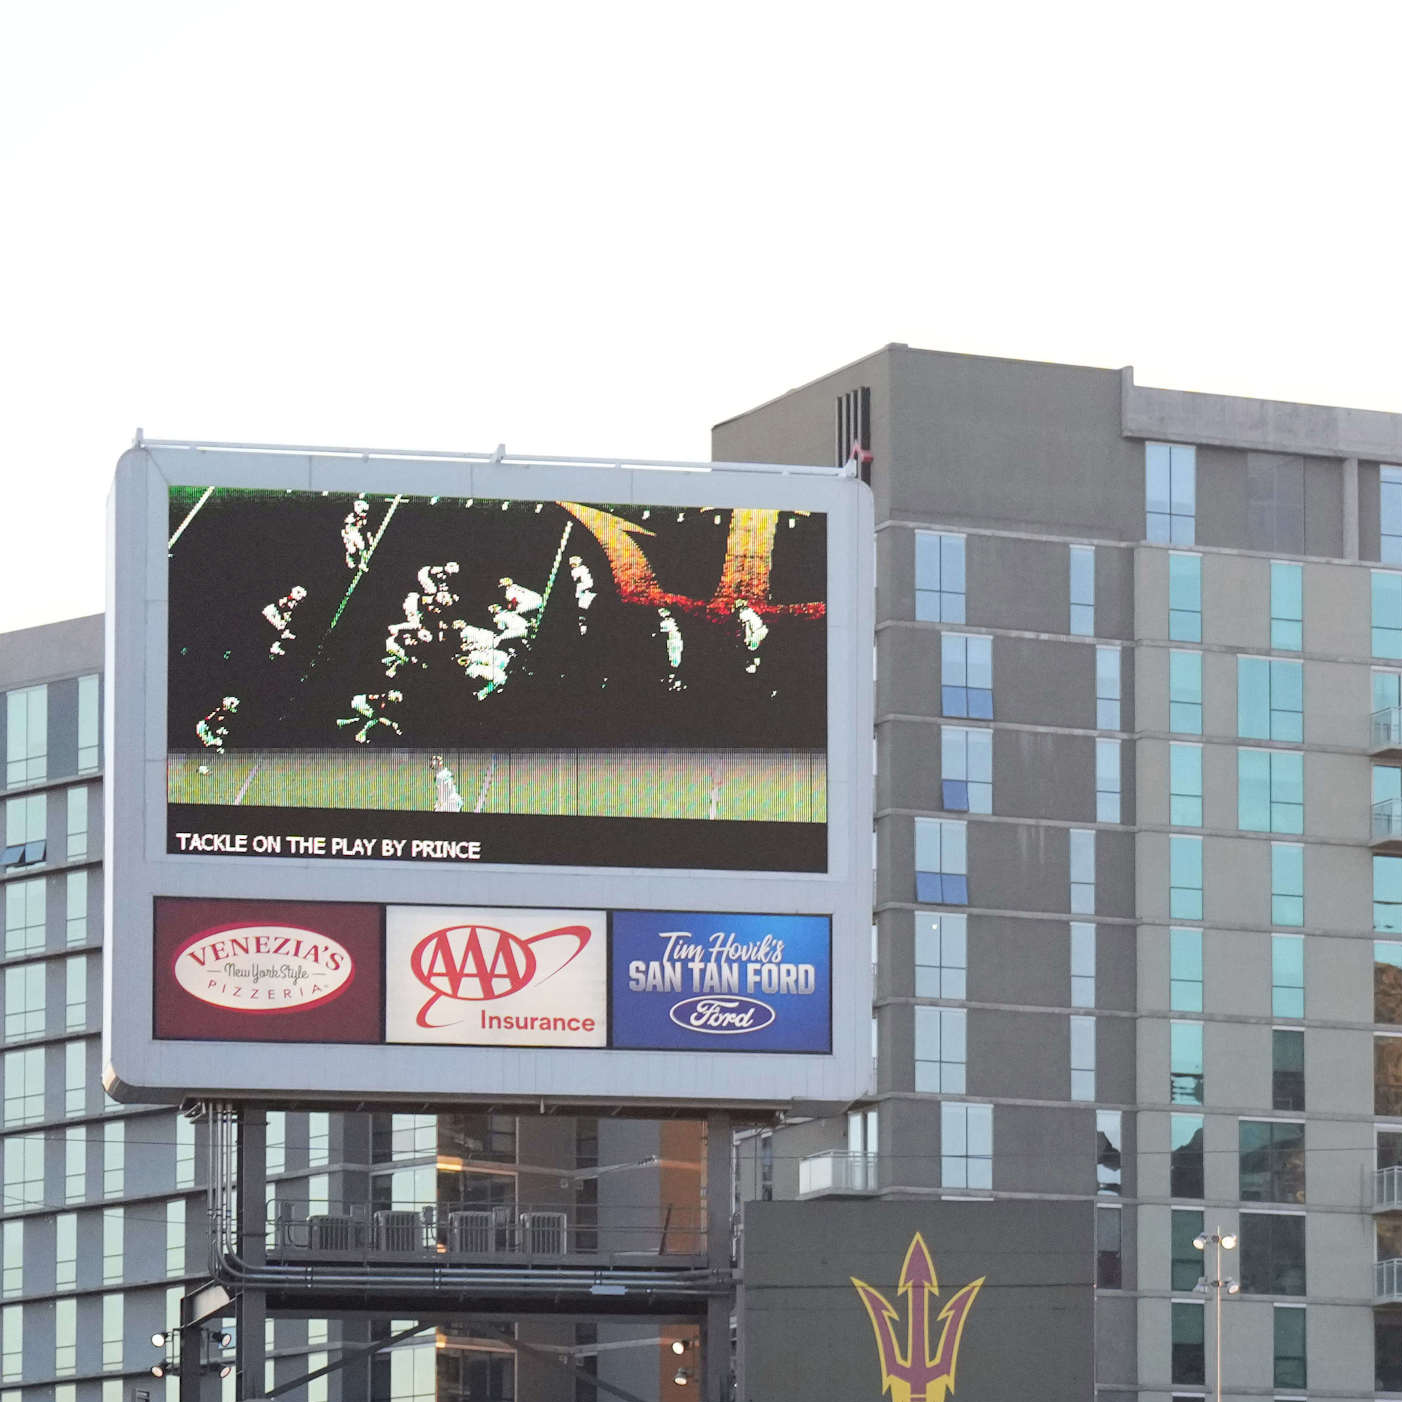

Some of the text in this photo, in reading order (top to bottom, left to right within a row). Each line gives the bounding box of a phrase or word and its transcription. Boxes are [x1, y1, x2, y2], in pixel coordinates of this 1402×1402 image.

[176, 832, 481, 861] TACKLE ON THE PLAY BY PRINCE
[186, 935, 345, 971] VENEZIA'S
[425, 927, 523, 1000] AAA
[658, 931, 785, 964] Tim Hovik's
[208, 978, 322, 1000] PIZZERIA
[629, 960, 815, 996] SAN TAN FORD
[481, 1009, 595, 1032] Insurance
[690, 999, 754, 1030] Ford
